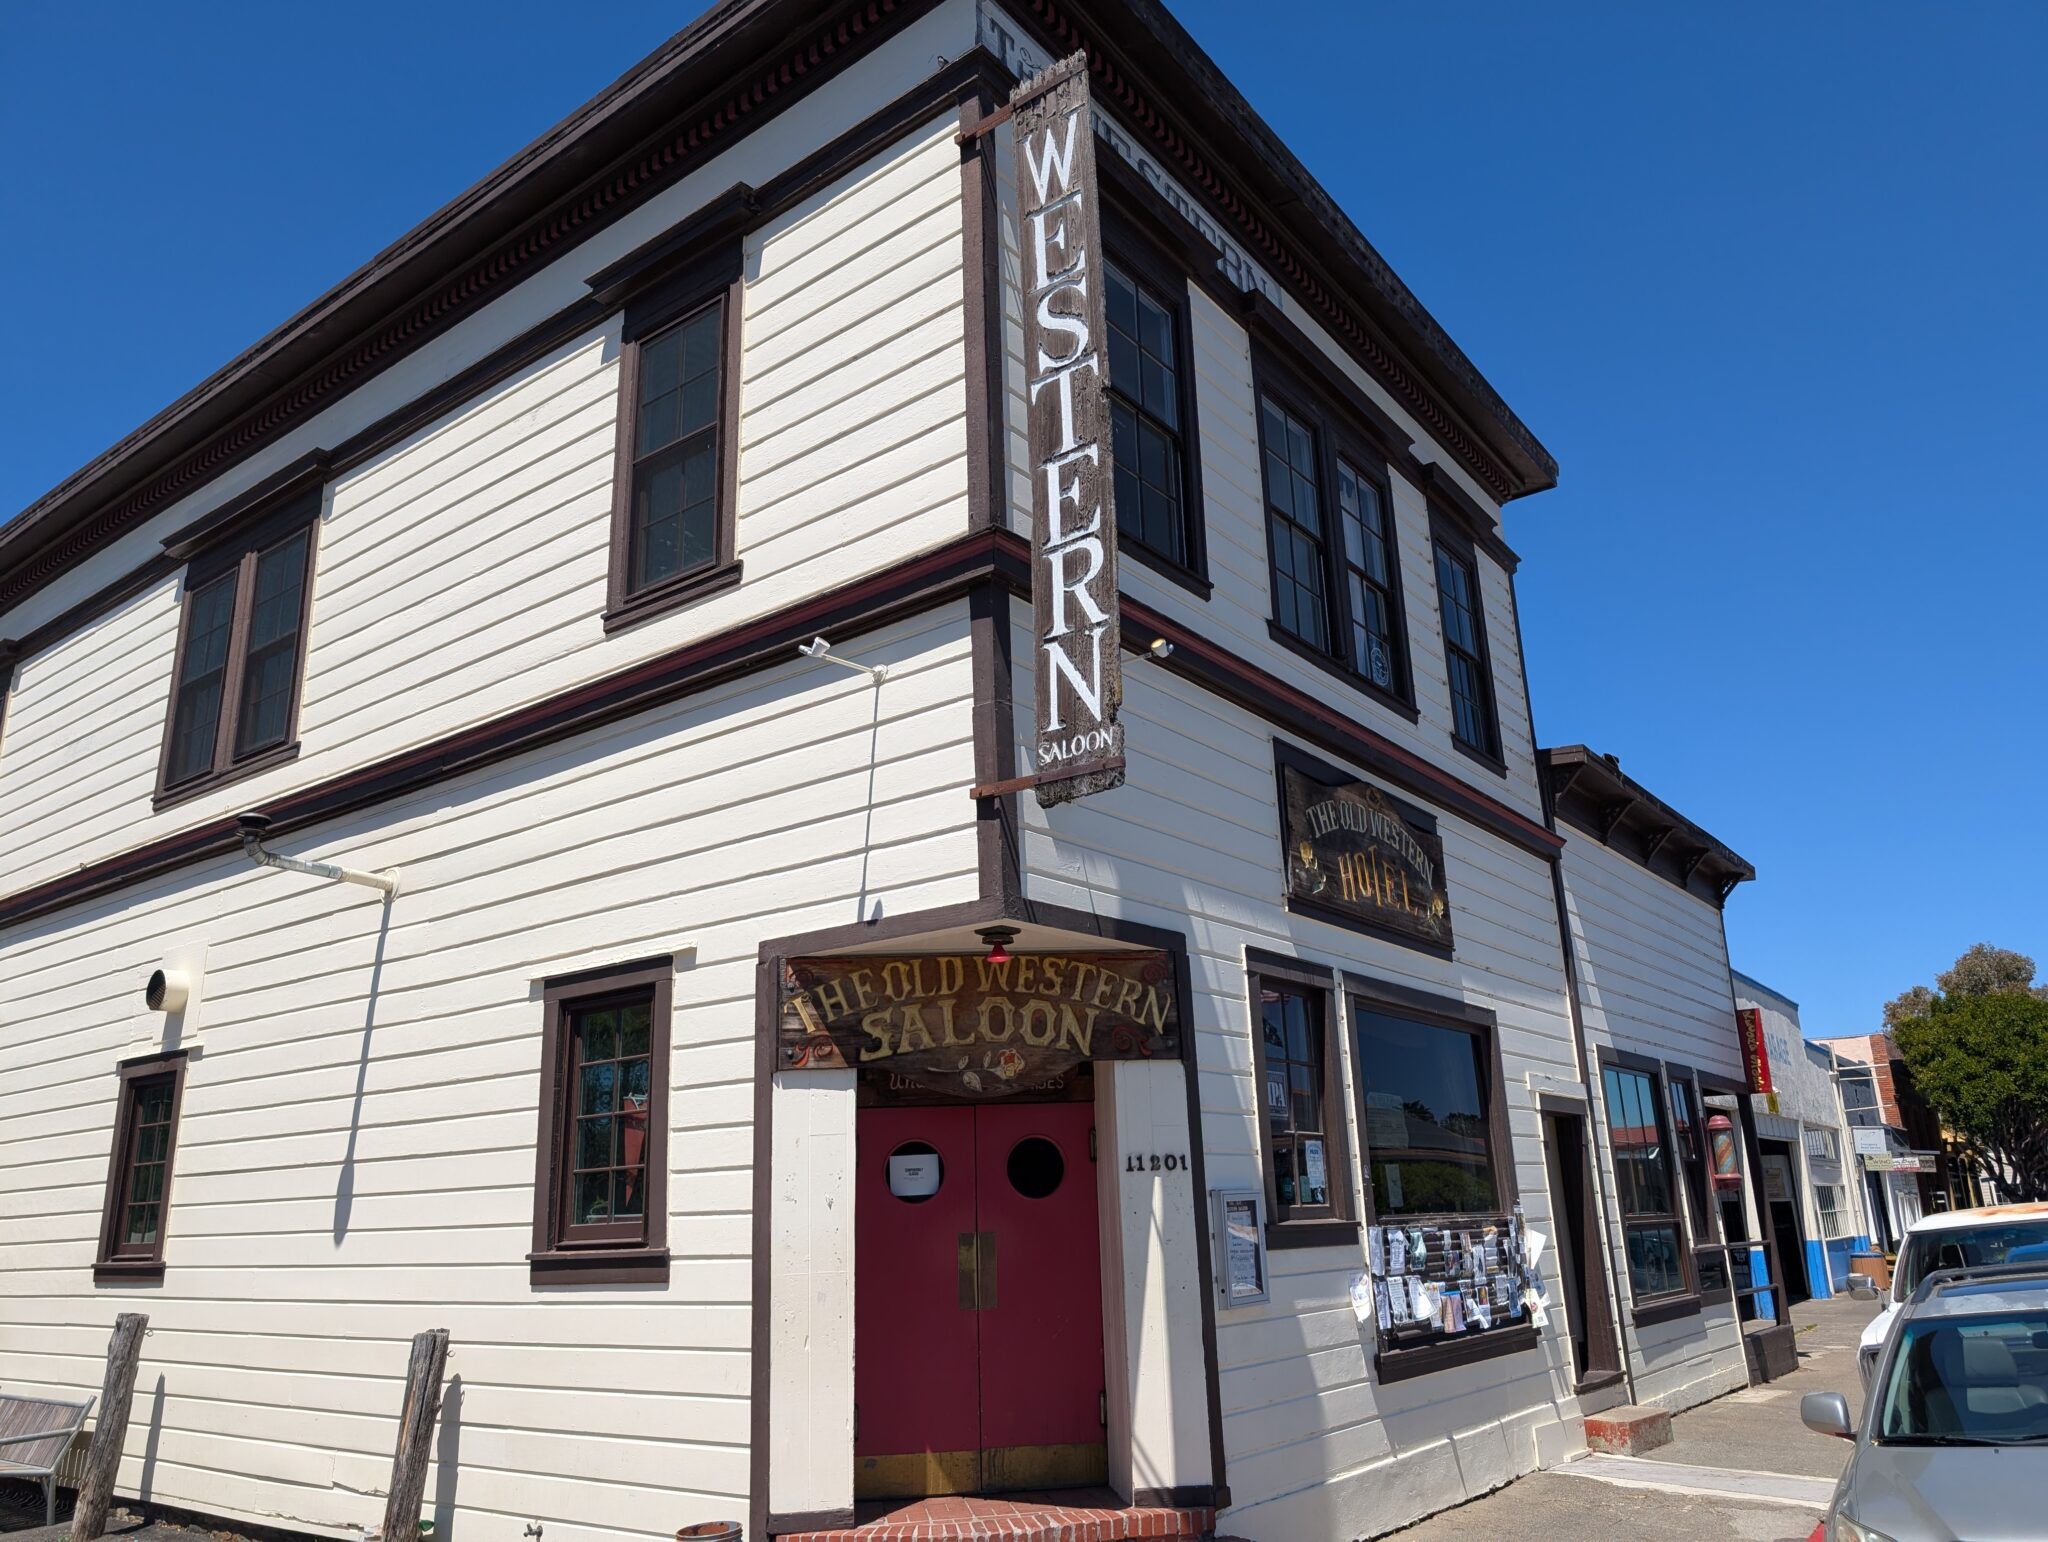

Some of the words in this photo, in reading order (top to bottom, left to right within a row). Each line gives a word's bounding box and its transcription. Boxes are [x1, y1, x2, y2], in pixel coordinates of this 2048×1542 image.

[1018, 104, 1110, 732] WESTERN
[1038, 730, 1114, 766] SALOON
[1306, 800, 1340, 838] THE
[1340, 800, 1368, 834] OLD
[1370, 811, 1435, 890] WESTERN
[1337, 845, 1419, 916] HOTEL
[784, 968, 879, 1034] THE
[881, 956, 965, 1001] OLD
[972, 955, 1172, 1035] WESTERN
[859, 996, 1100, 1062] SALOON
[1267, 1081, 1287, 1107] IPA
[1125, 1153, 1188, 1172] 11201
